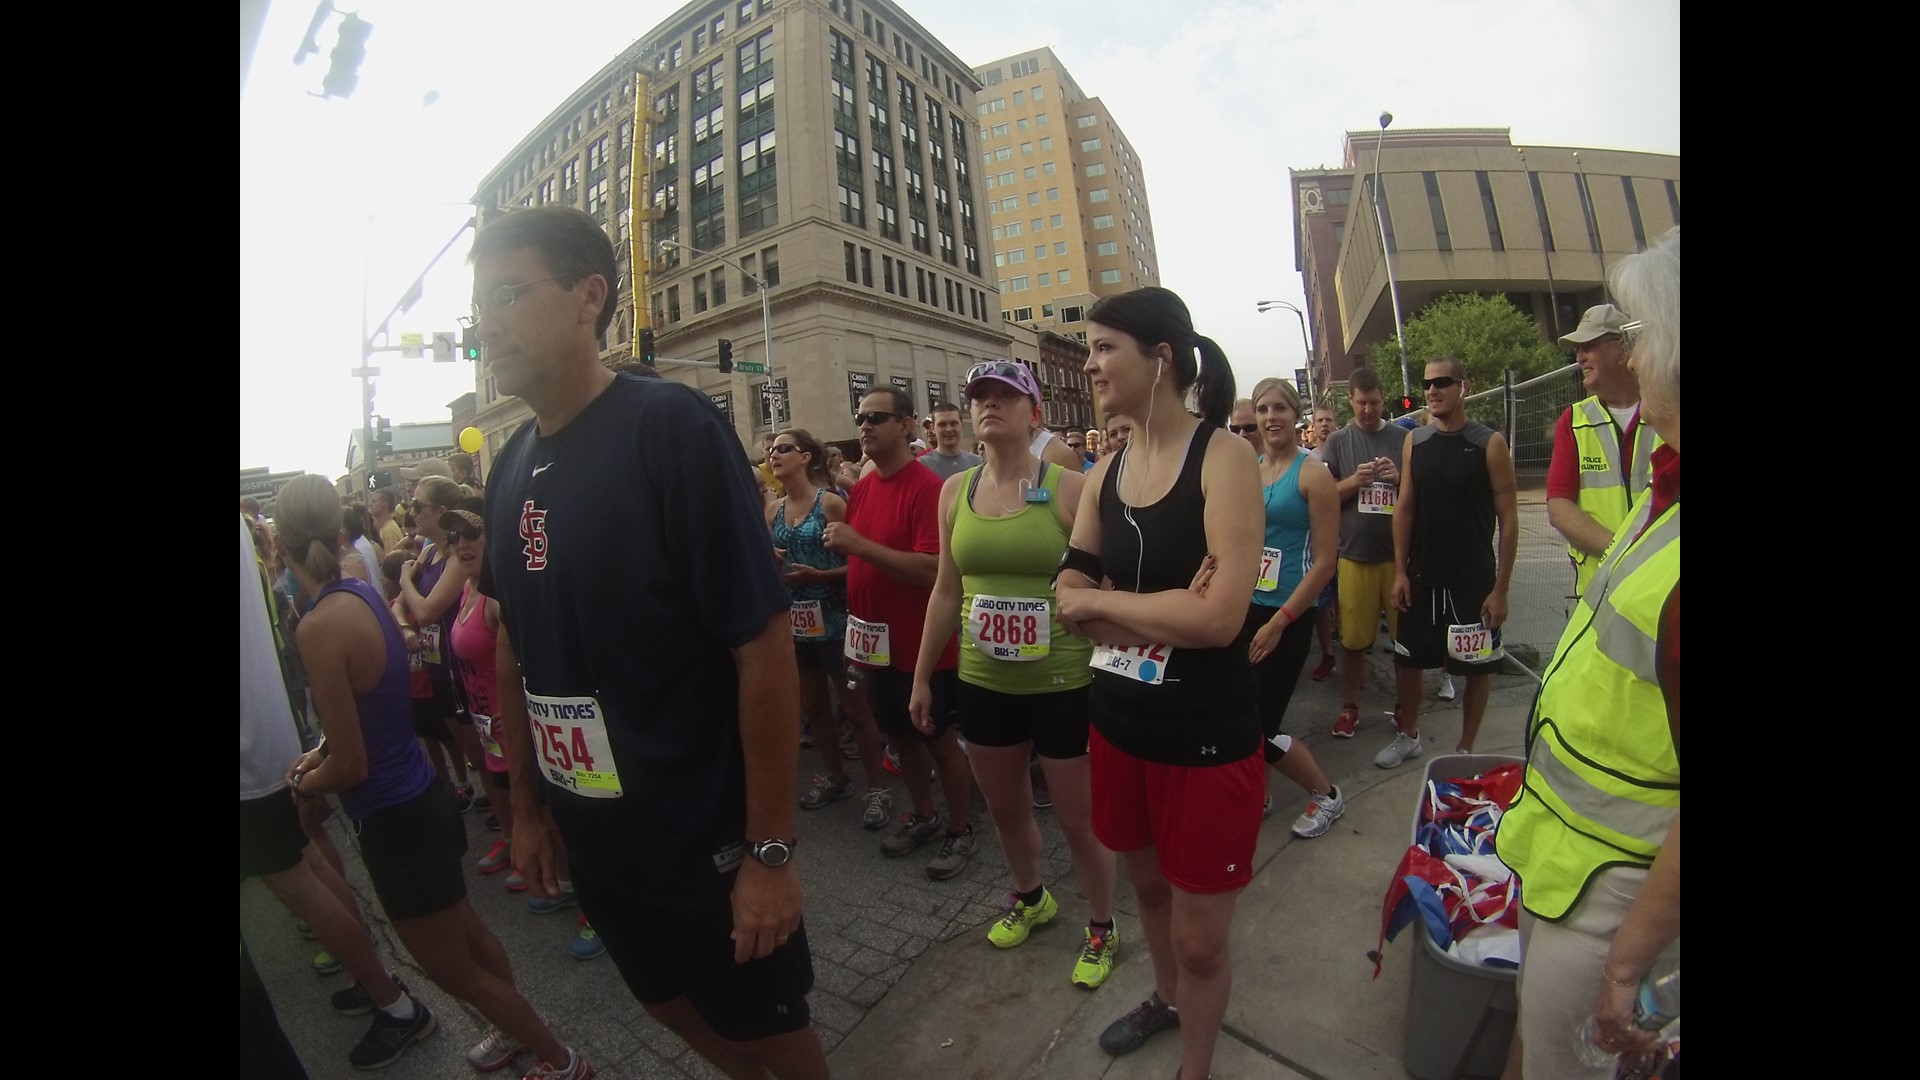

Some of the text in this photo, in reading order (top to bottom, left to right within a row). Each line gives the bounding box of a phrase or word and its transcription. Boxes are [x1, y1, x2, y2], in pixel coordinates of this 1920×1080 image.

[739, 363, 754, 372] Brady
[1361, 490, 1394, 506] 11681
[996, 601, 1015, 611] CITY
[1017, 602, 1046, 611] TIMES
[979, 612, 1037, 646] 2868
[850, 628, 880, 654] 8767
[1455, 632, 1486, 653] 3327
[994, 647, 1020, 658] BIX-7
[550, 703, 596, 720] TIMES
[529, 719, 595, 772] 254
